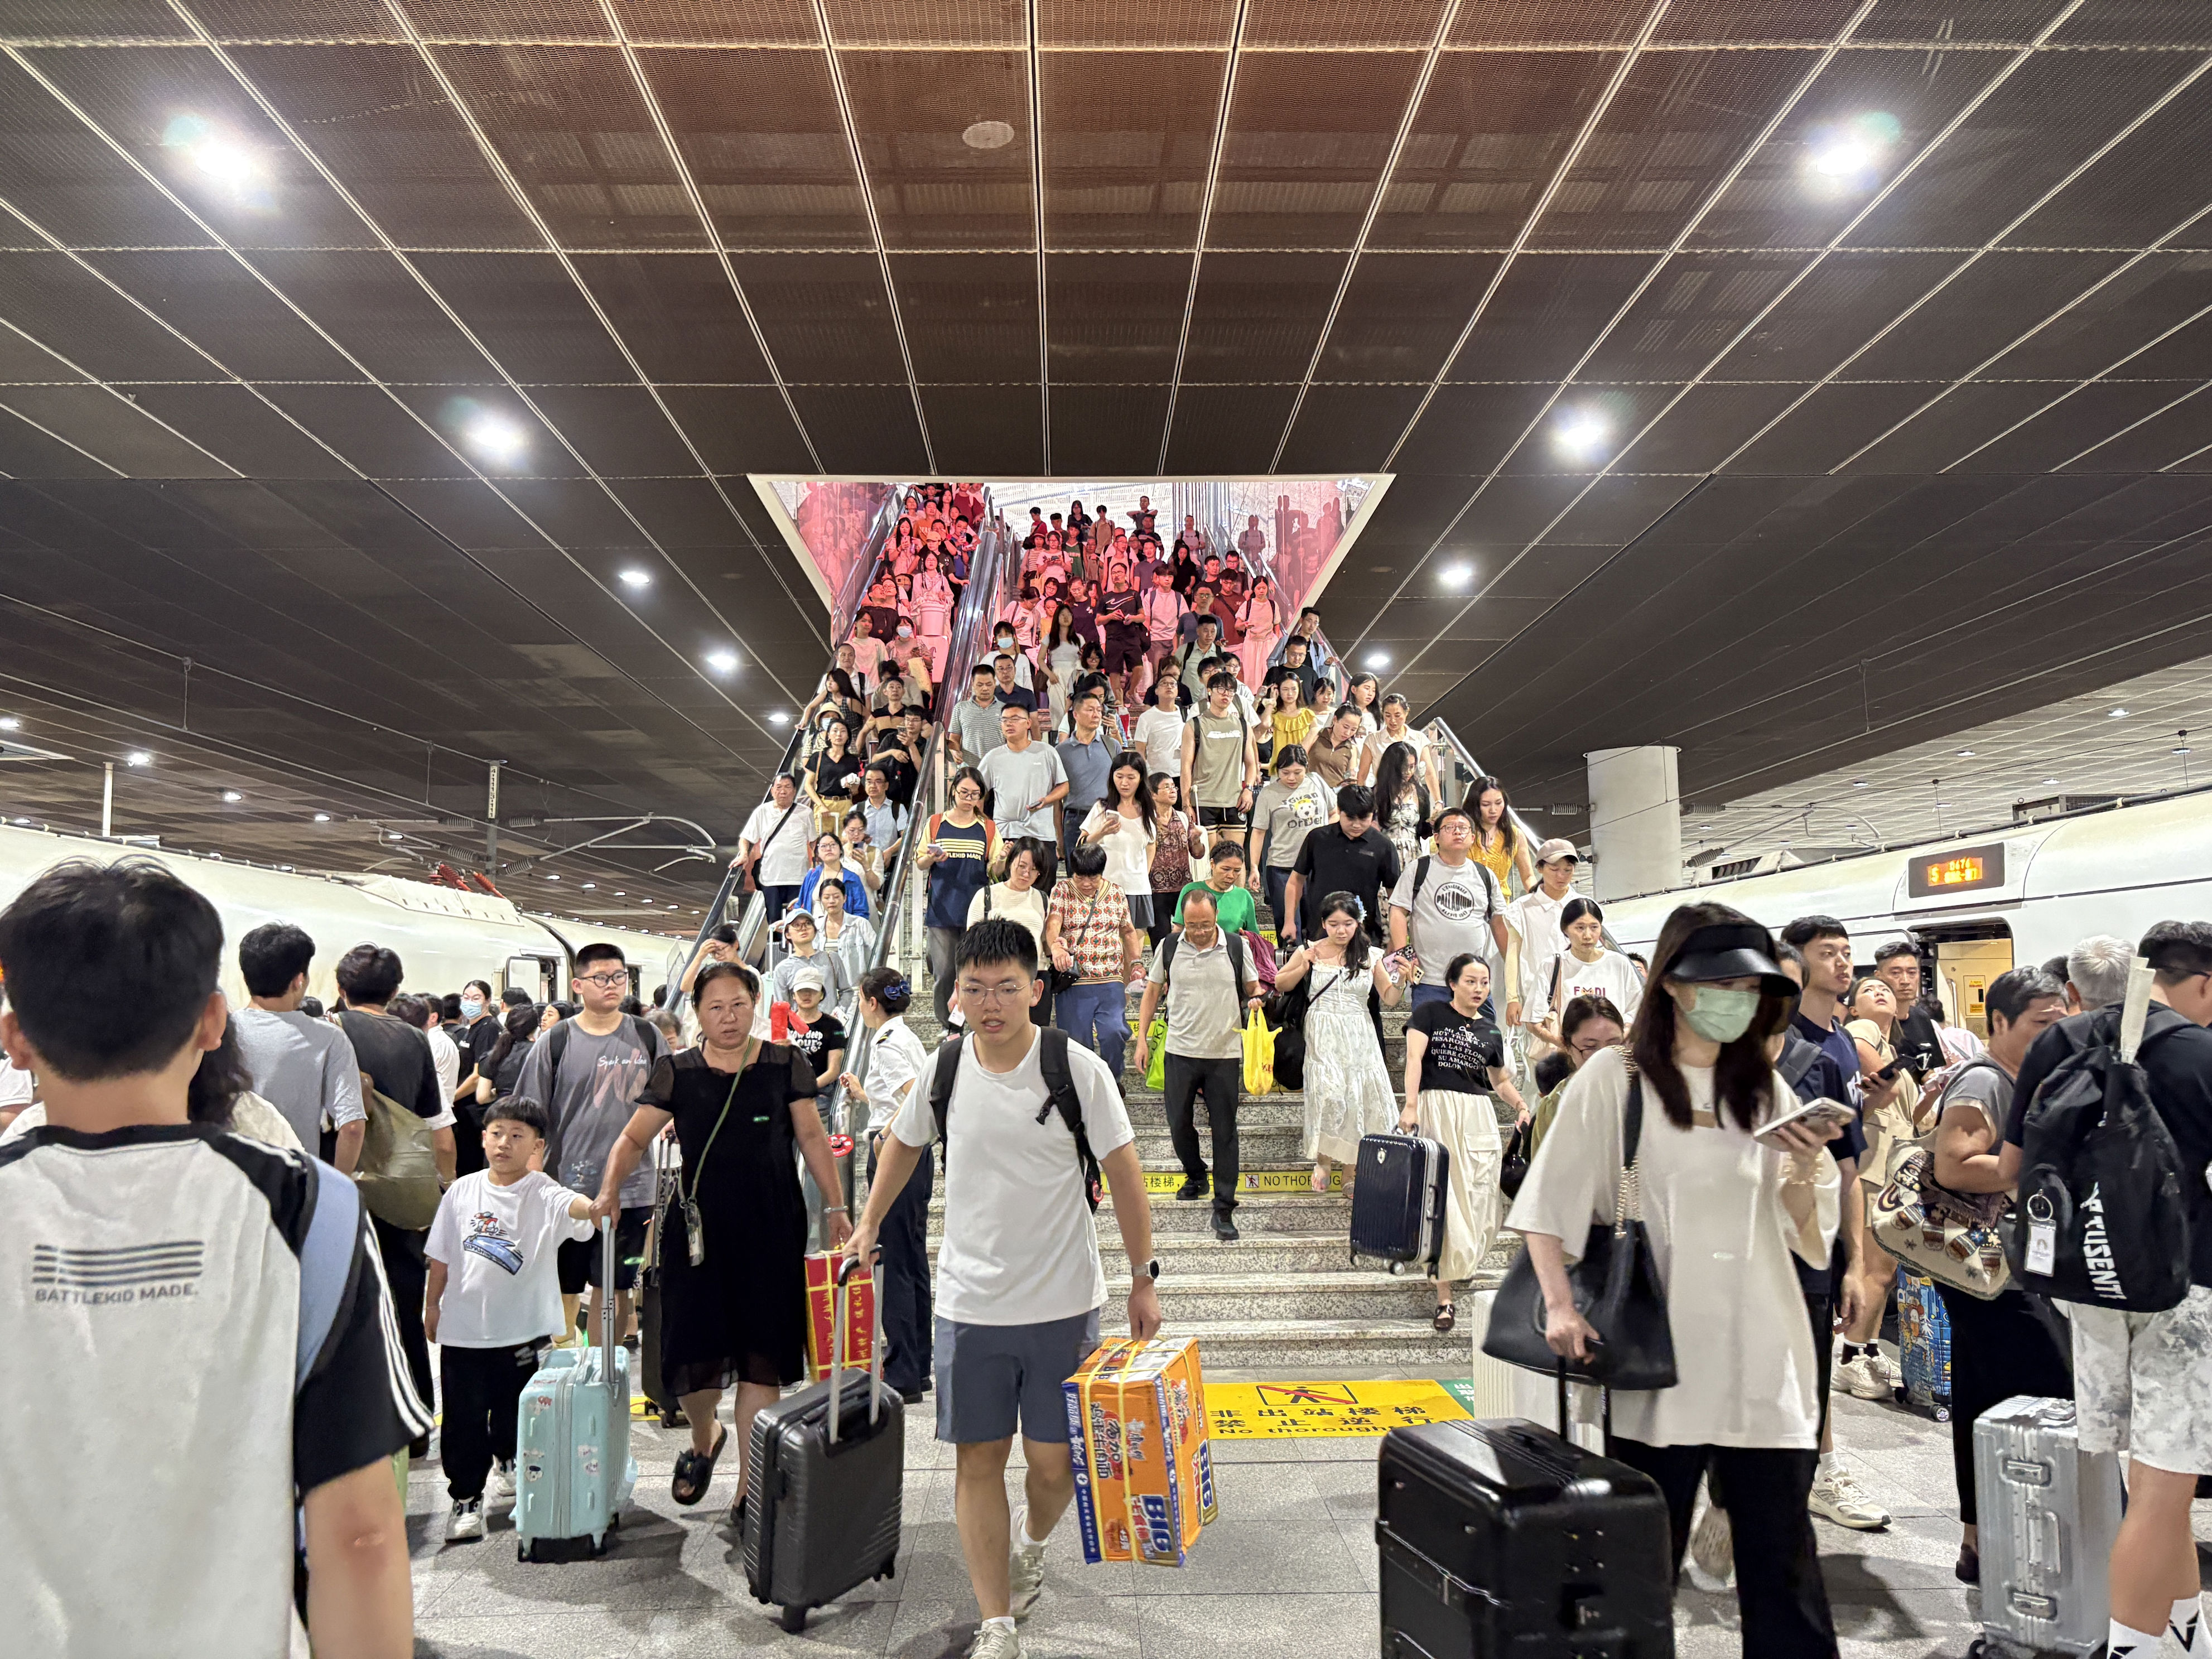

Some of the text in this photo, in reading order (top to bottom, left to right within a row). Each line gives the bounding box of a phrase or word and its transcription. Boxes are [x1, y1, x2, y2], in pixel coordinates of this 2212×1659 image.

[1437, 891, 1472, 912] PALLADIUM
[1264, 1176, 1280, 1186] NO
[35, 1289, 134, 1305] BATTLEKID
[1210, 1406, 1426, 1417] 非出站楼梯
[1215, 1416, 1434, 1427] 禁止逆行
[1267, 1425, 1396, 1434] thorough
[1198, 1439, 1214, 1510] BIG
[1139, 1494, 1173, 1554] BIG
